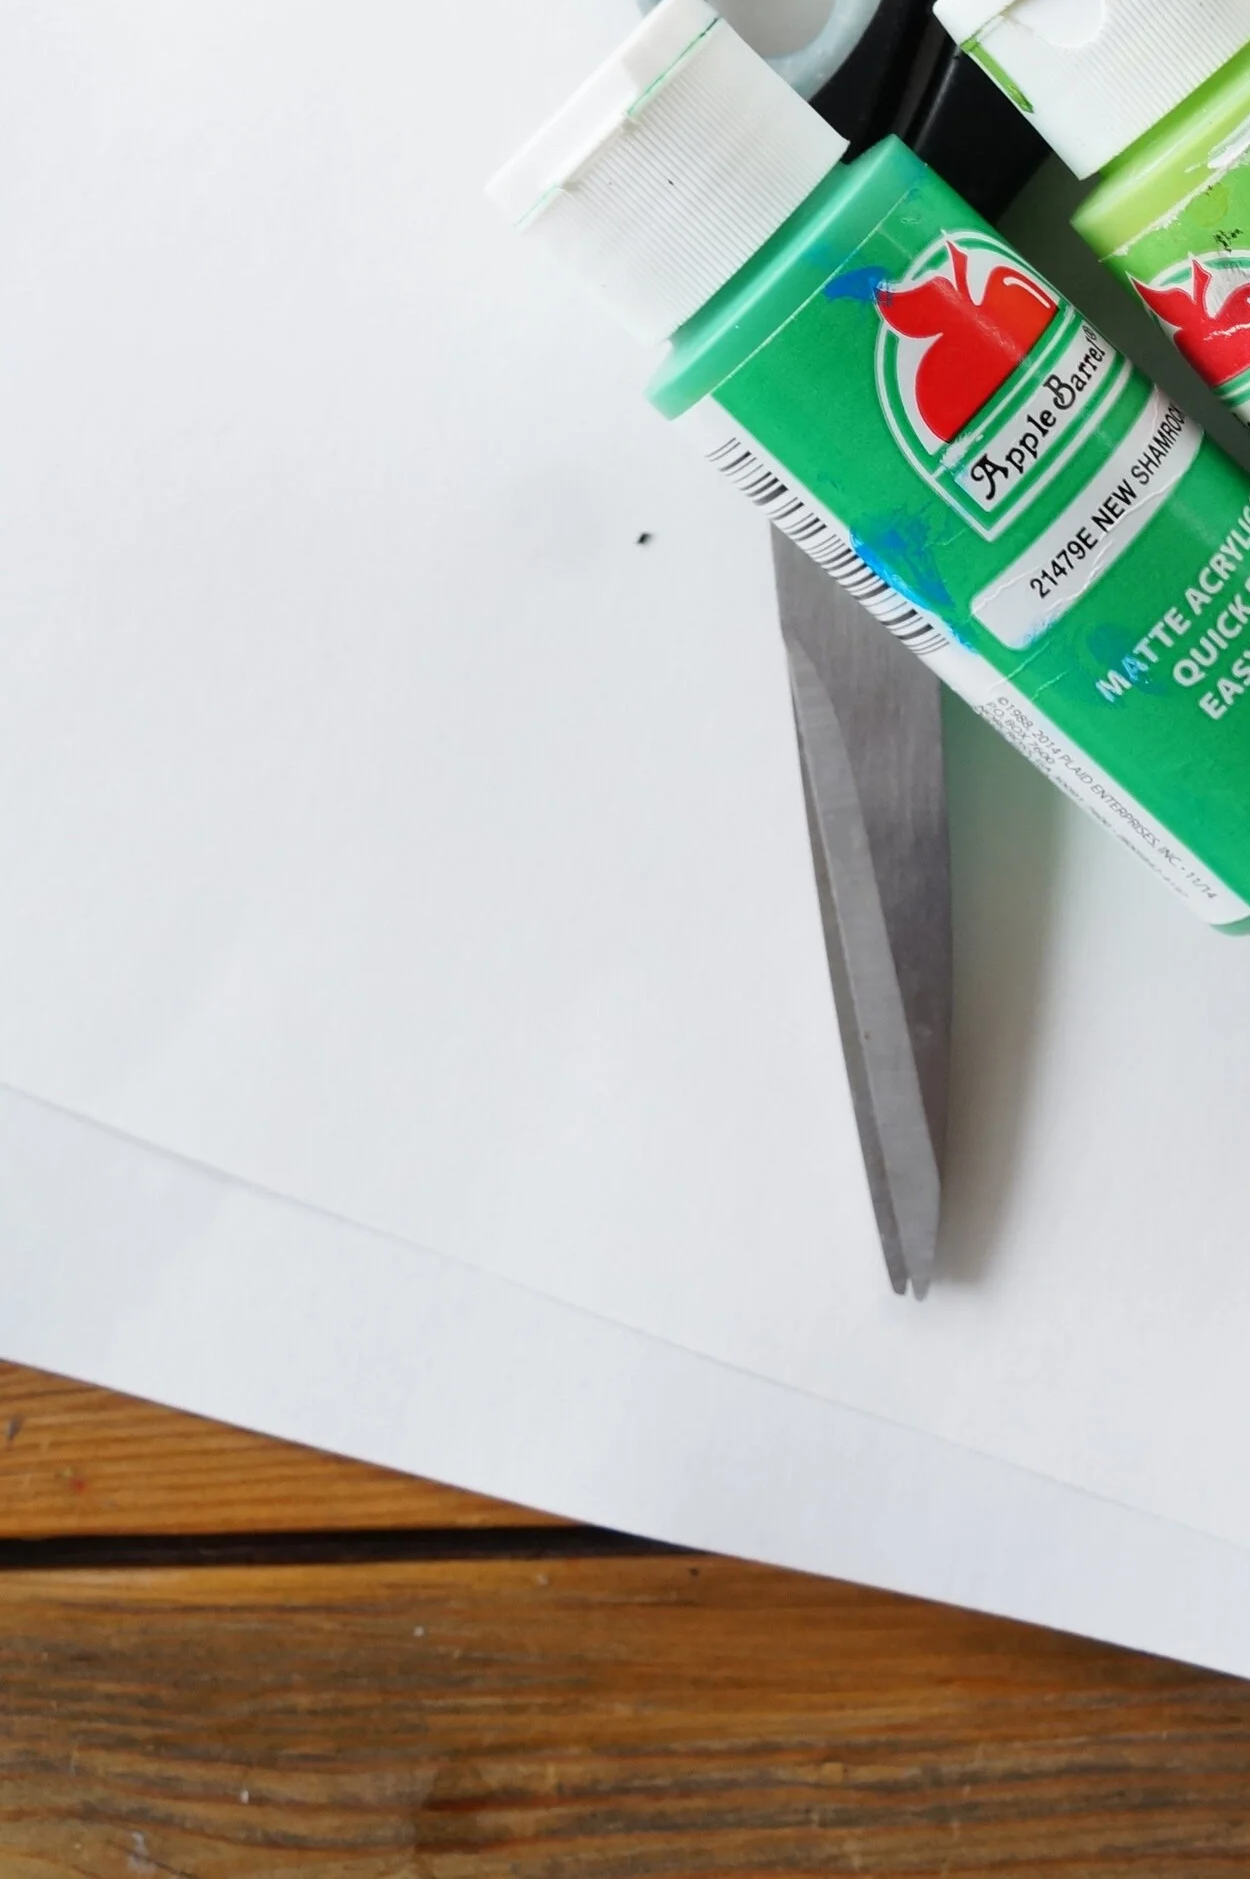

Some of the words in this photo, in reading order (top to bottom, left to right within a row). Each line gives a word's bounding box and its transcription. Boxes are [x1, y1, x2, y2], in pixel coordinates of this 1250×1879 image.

[970, 408, 1057, 501] Apple
[1030, 527, 1098, 599] 21479E
[1090, 478, 1138, 532] NEW
[1095, 607, 1192, 703] MATTE
[1058, 754, 1094, 785] PLAID
